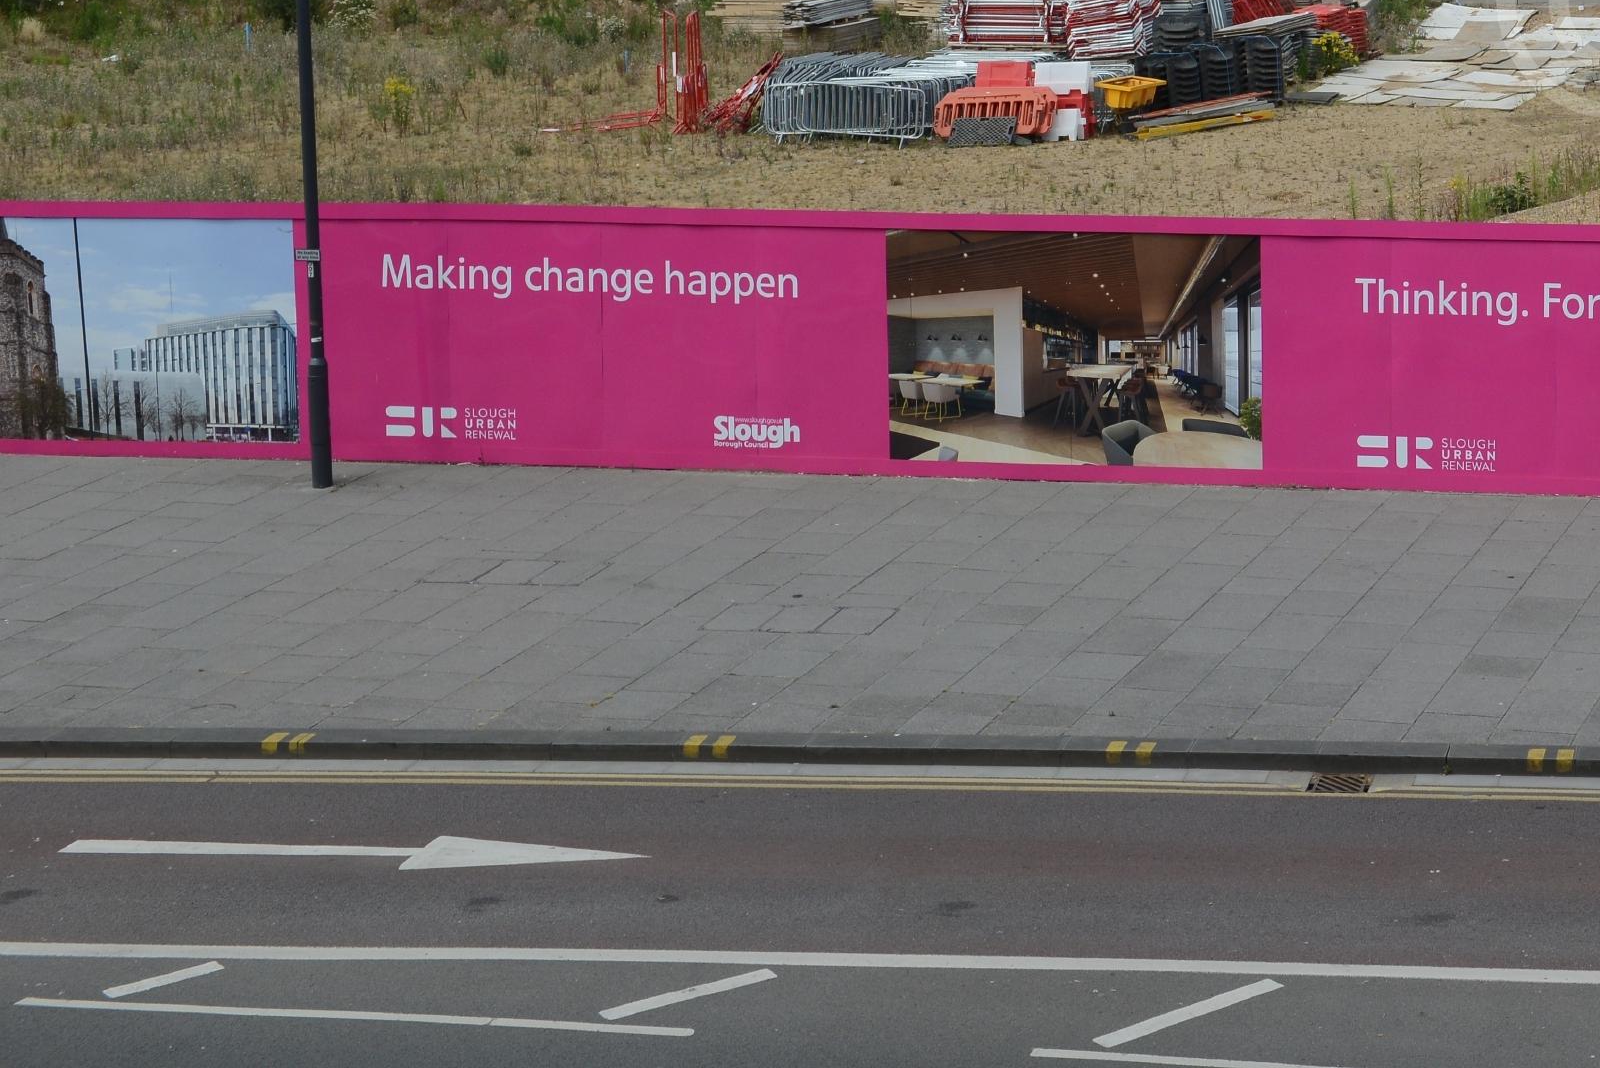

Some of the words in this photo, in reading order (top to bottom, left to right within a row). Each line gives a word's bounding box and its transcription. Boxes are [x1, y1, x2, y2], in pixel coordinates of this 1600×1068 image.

[382, 254, 512, 299] Making
[525, 257, 654, 302] change
[664, 260, 799, 305] happen
[1355, 278, 1529, 326] Thinking.
[464, 407, 516, 419] SLOUGH
[464, 419, 516, 430] URBAN
[465, 430, 516, 440] RENEWAL
[714, 416, 801, 449] Slough
[713, 440, 742, 448] Borough
[744, 441, 769, 449] Council
[1441, 437, 1496, 449] SLOUGH
[1441, 449, 1496, 460] URBAN
[1441, 460, 1496, 472] RENEWAL
